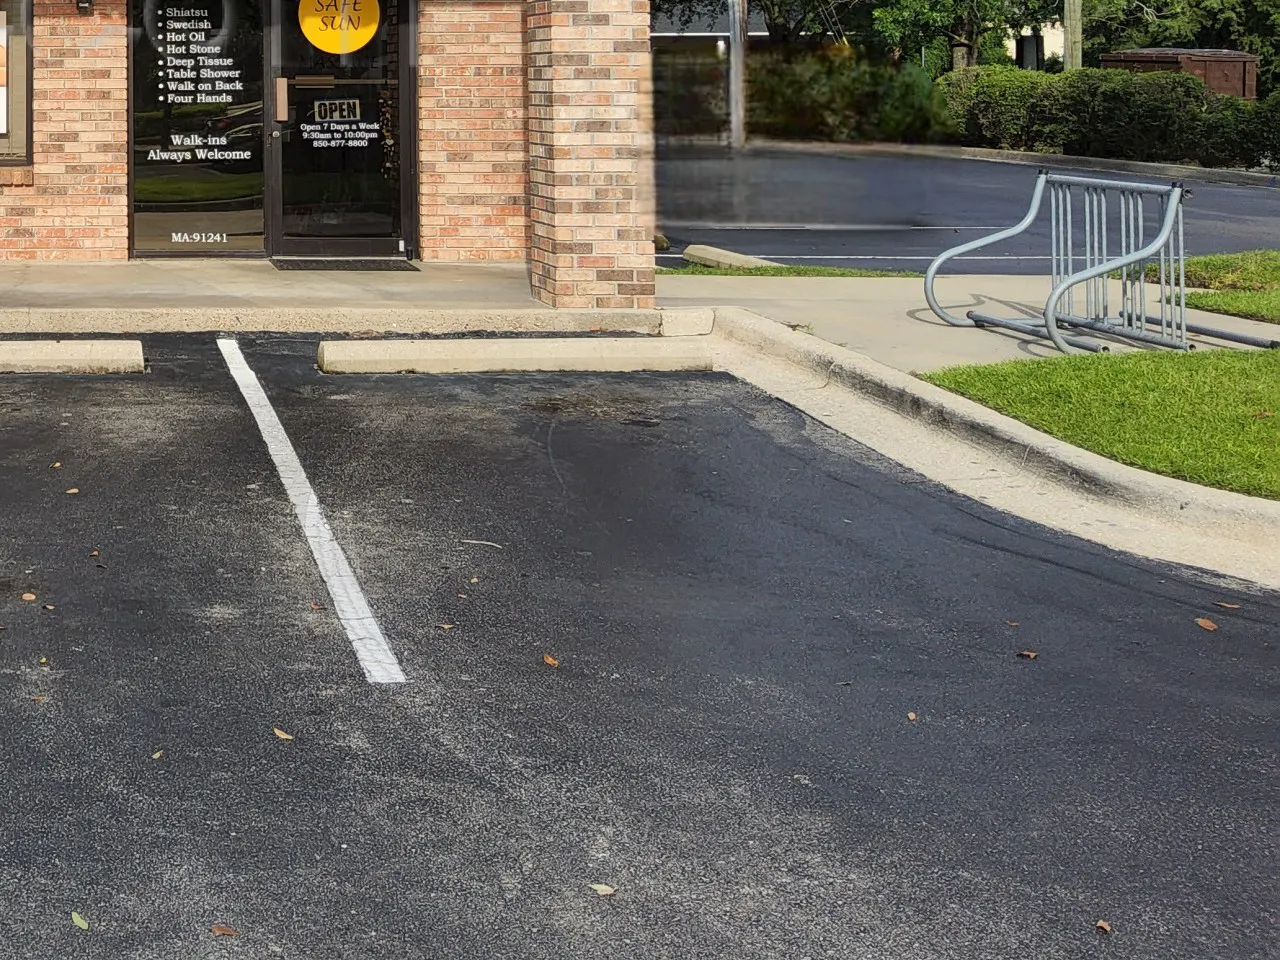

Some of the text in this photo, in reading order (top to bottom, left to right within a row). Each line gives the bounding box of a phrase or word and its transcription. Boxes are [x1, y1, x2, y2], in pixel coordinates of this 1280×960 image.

[166, 7, 208, 17] Shiatsu
[166, 19, 212, 29] Swedish
[318, 15, 361, 32] SUN
[166, 31, 206, 42] Hot Oil
[166, 44, 221, 54] Hot Stone
[167, 56, 234, 68] Deep Tissue
[167, 68, 241, 79] Table Shower
[167, 80, 243, 91] Walk on Back
[167, 93, 233, 103] Four Hands
[317, 101, 357, 120] OPEN
[300, 123, 321, 132] Open
[330, 123, 350, 131] Days
[359, 122, 380, 130] Week
[170, 134, 228, 146] Walk-ins
[302, 131, 332, 139] 9:30am
[344, 131, 378, 140] 10:00pm
[312, 140, 369, 148] 850-877-8800
[147, 148, 252, 163] Always Welcome
[171, 232, 228, 243] MA:91241
